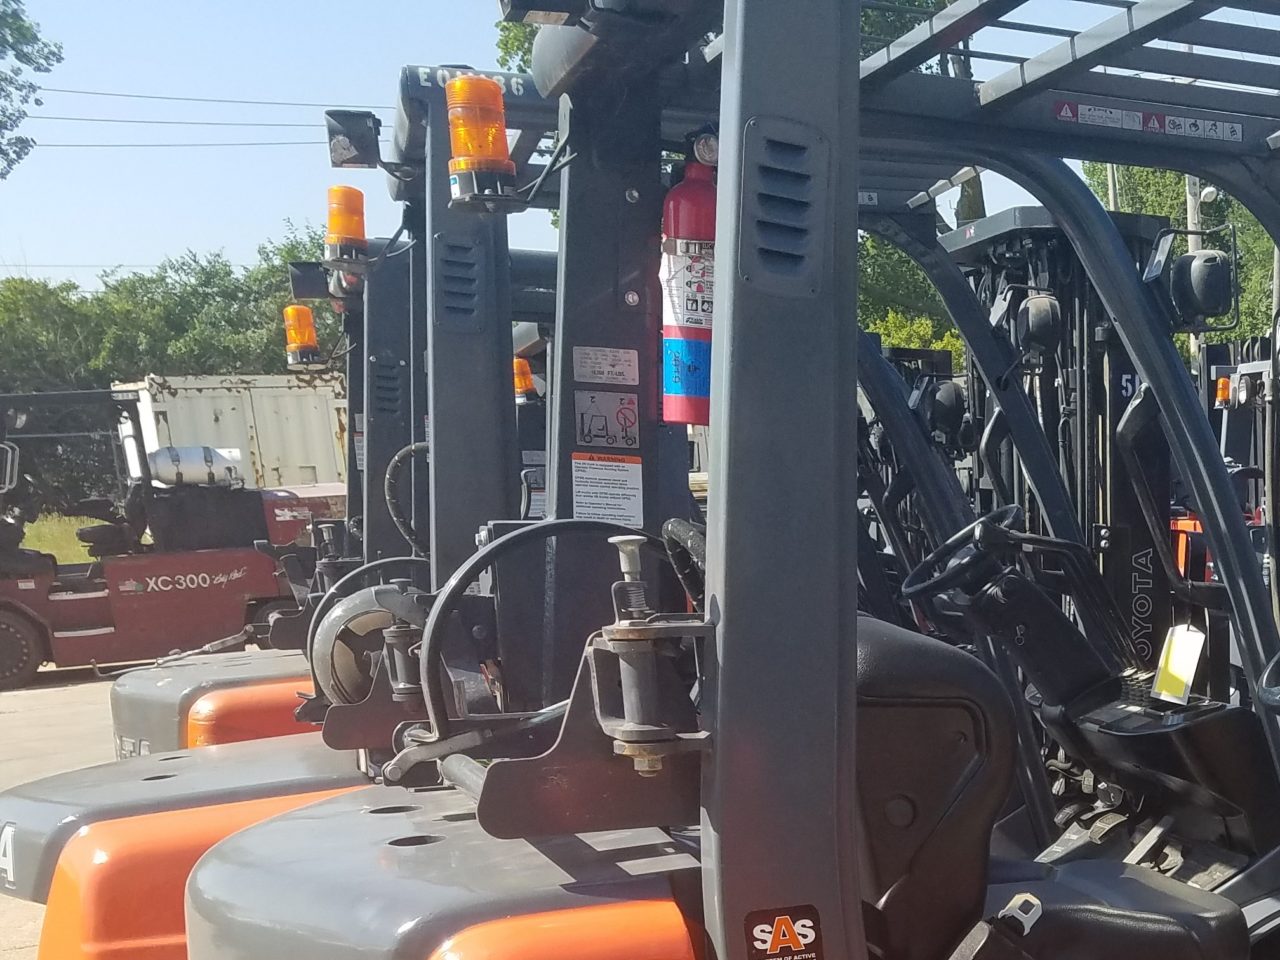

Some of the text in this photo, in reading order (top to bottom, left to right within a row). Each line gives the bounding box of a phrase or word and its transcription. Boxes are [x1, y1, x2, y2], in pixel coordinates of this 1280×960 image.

[145, 573, 210, 592] XC300
[752, 915, 816, 954] SAS
[793, 952, 816, 960] ACTIVE
